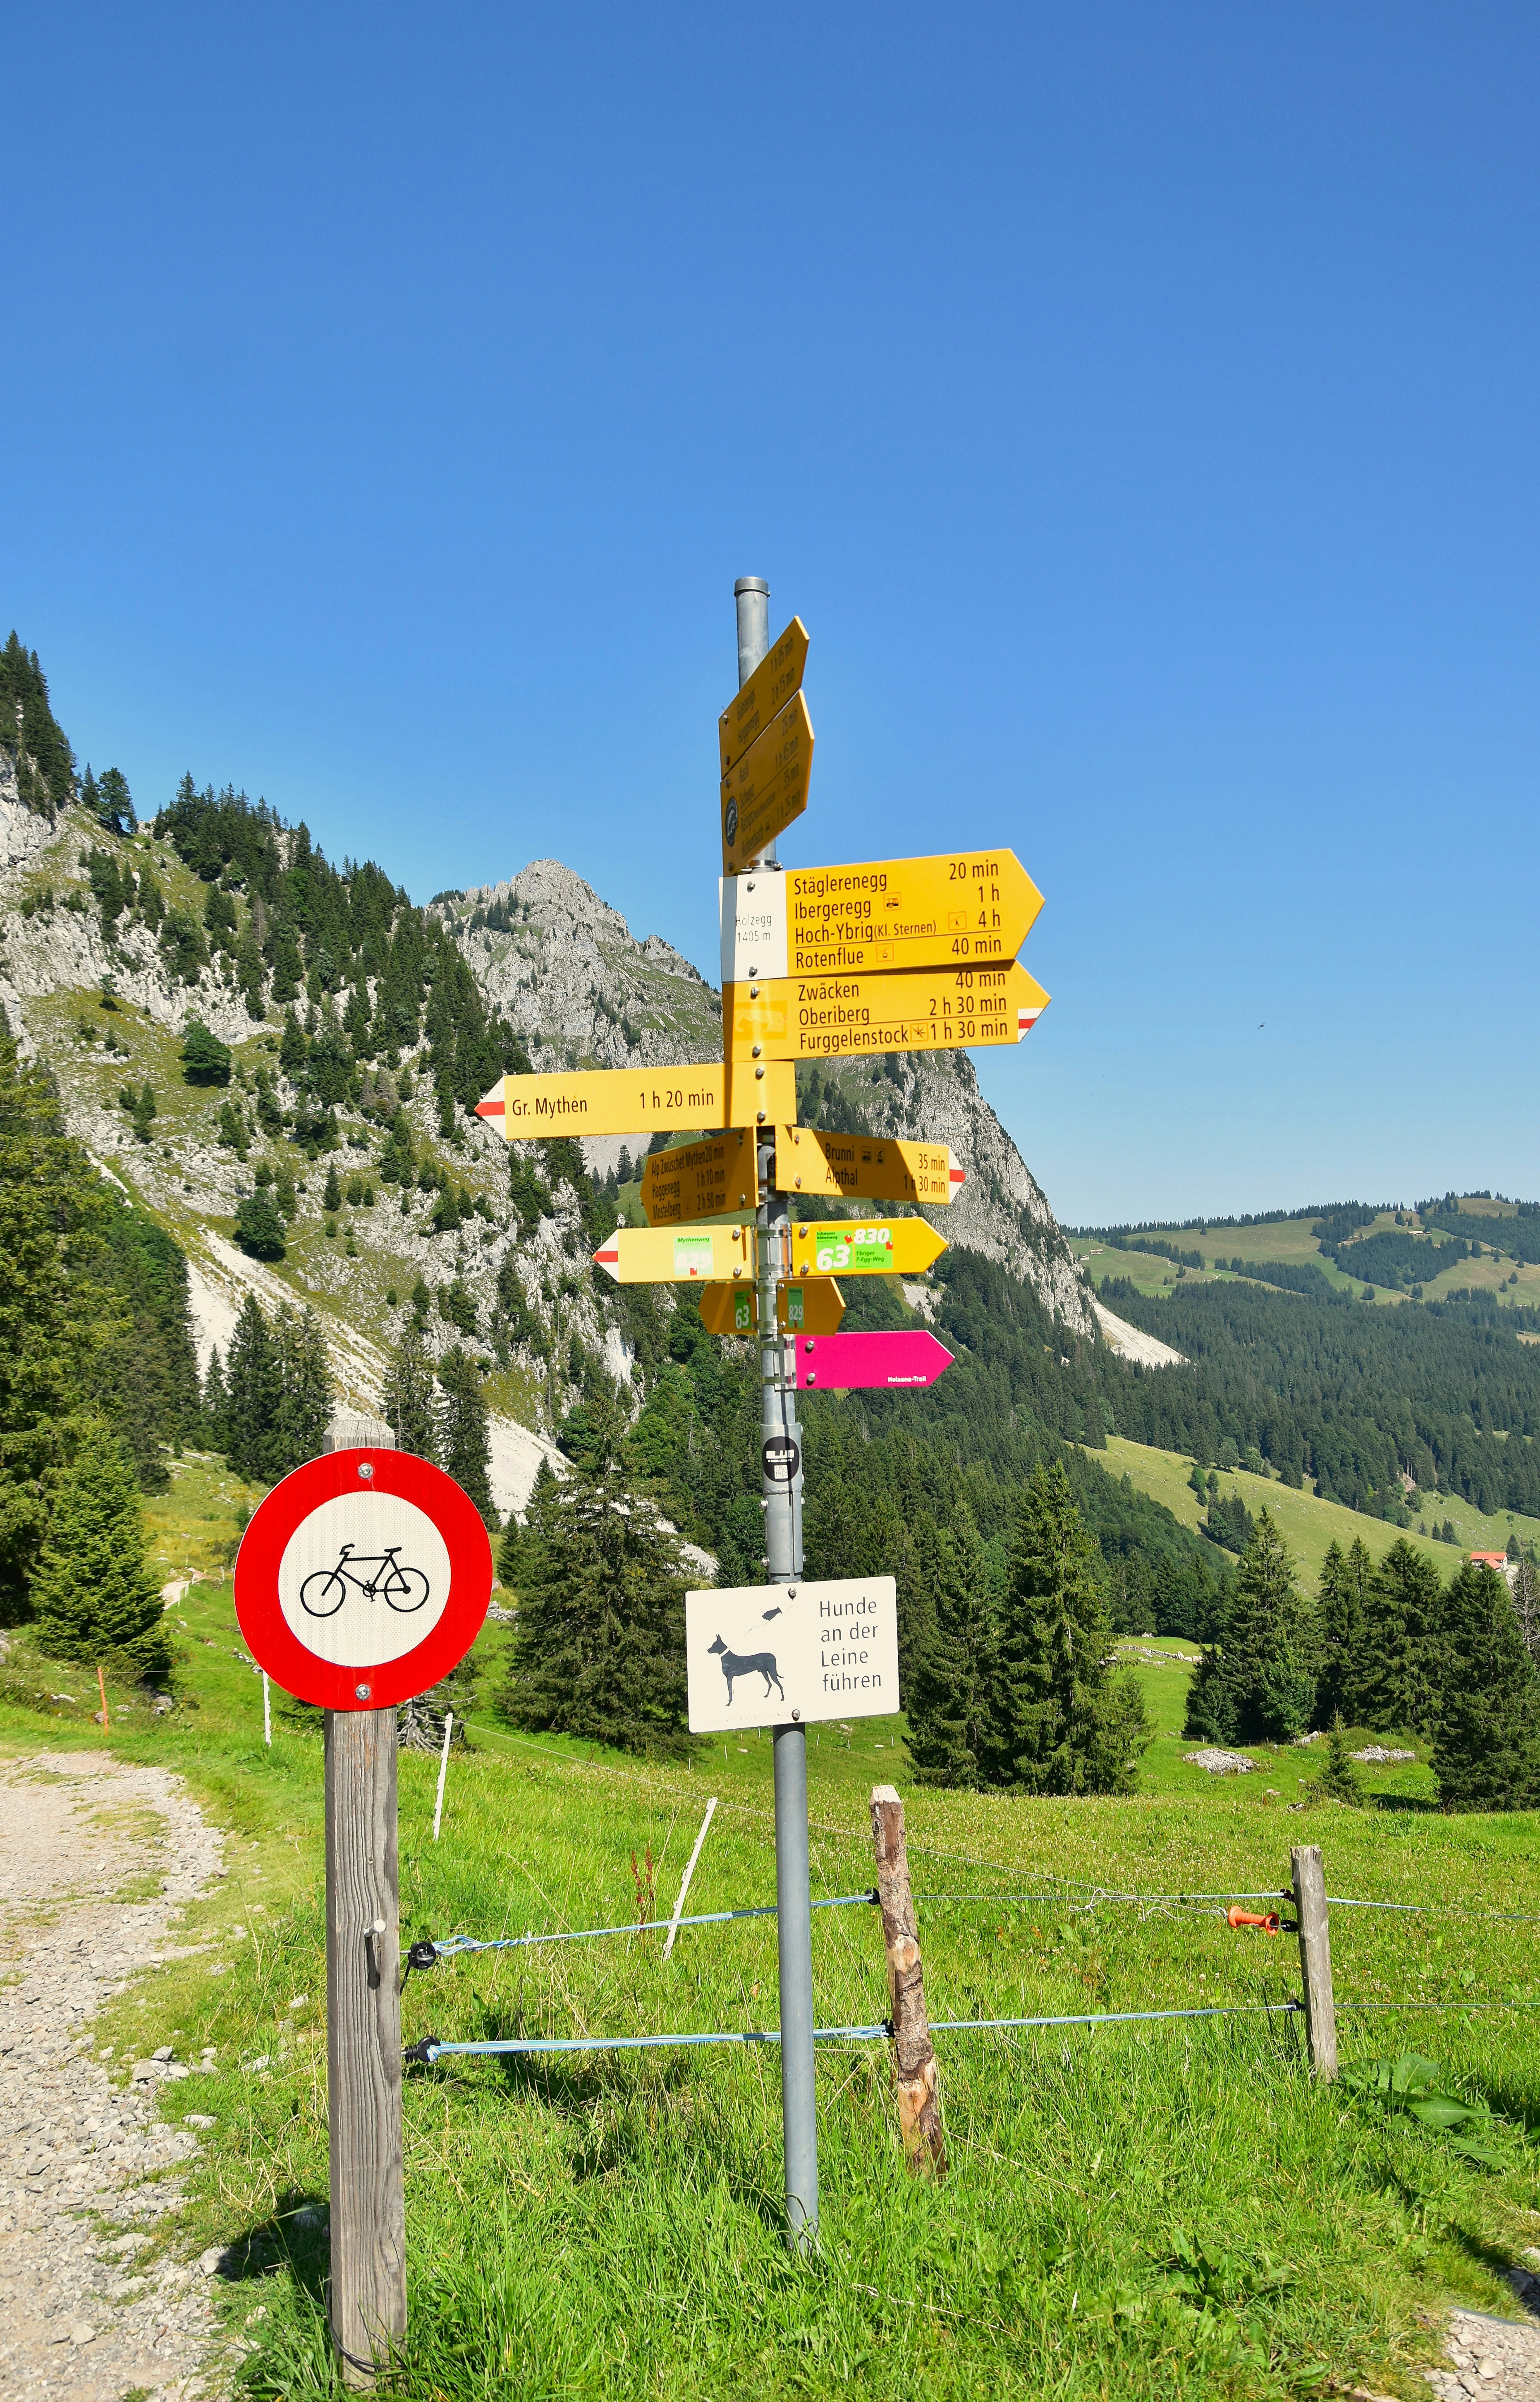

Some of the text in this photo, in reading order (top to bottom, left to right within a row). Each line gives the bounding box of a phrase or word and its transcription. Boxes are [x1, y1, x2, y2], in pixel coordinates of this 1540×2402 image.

[794, 859, 998, 897] Stäglerenegg 20 min
[795, 883, 1000, 922] Ibergeregg 1 h
[735, 914, 771, 927] Holzegg
[796, 922, 873, 944] Hoch-Ybrig
[894, 919, 937, 936] Sternen)
[978, 911, 987, 928] 4
[992, 909, 1000, 927] h
[738, 931, 758, 943] 1405
[796, 935, 1001, 969] Rotenflue 40 min
[798, 969, 1005, 1001] Zwäcken 40 min
[799, 993, 1006, 1025] Oberiberg 2 h 30 min
[800, 1018, 1007, 1053] Furggelenstock 1 h 30 min
[512, 1088, 713, 1119] Gr. Mythen 1 h 20 min
[661, 1155, 684, 1174] Zwüschet
[686, 1149, 705, 1171] Mythen
[705, 1146, 712, 1162] 20
[714, 1142, 724, 1160] min
[825, 1142, 945, 1171] Brunni 35 min
[653, 1166, 725, 1201] Haggenegg 1 h 10 min
[825, 1166, 945, 1193] Alpthal 1 h 30 min
[653, 1189, 726, 1220] Mostelberg 2 h 50 min
[854, 1228, 890, 1244] 830
[676, 1252, 712, 1269] 829
[817, 1244, 850, 1271] 63
[736, 1305, 749, 1329] 63
[789, 1305, 803, 1320] 829
[820, 1596, 877, 1617] Hunde
[821, 1622, 878, 1642] an der
[821, 1648, 868, 1667] Leine
[822, 1672, 881, 1691] führen
